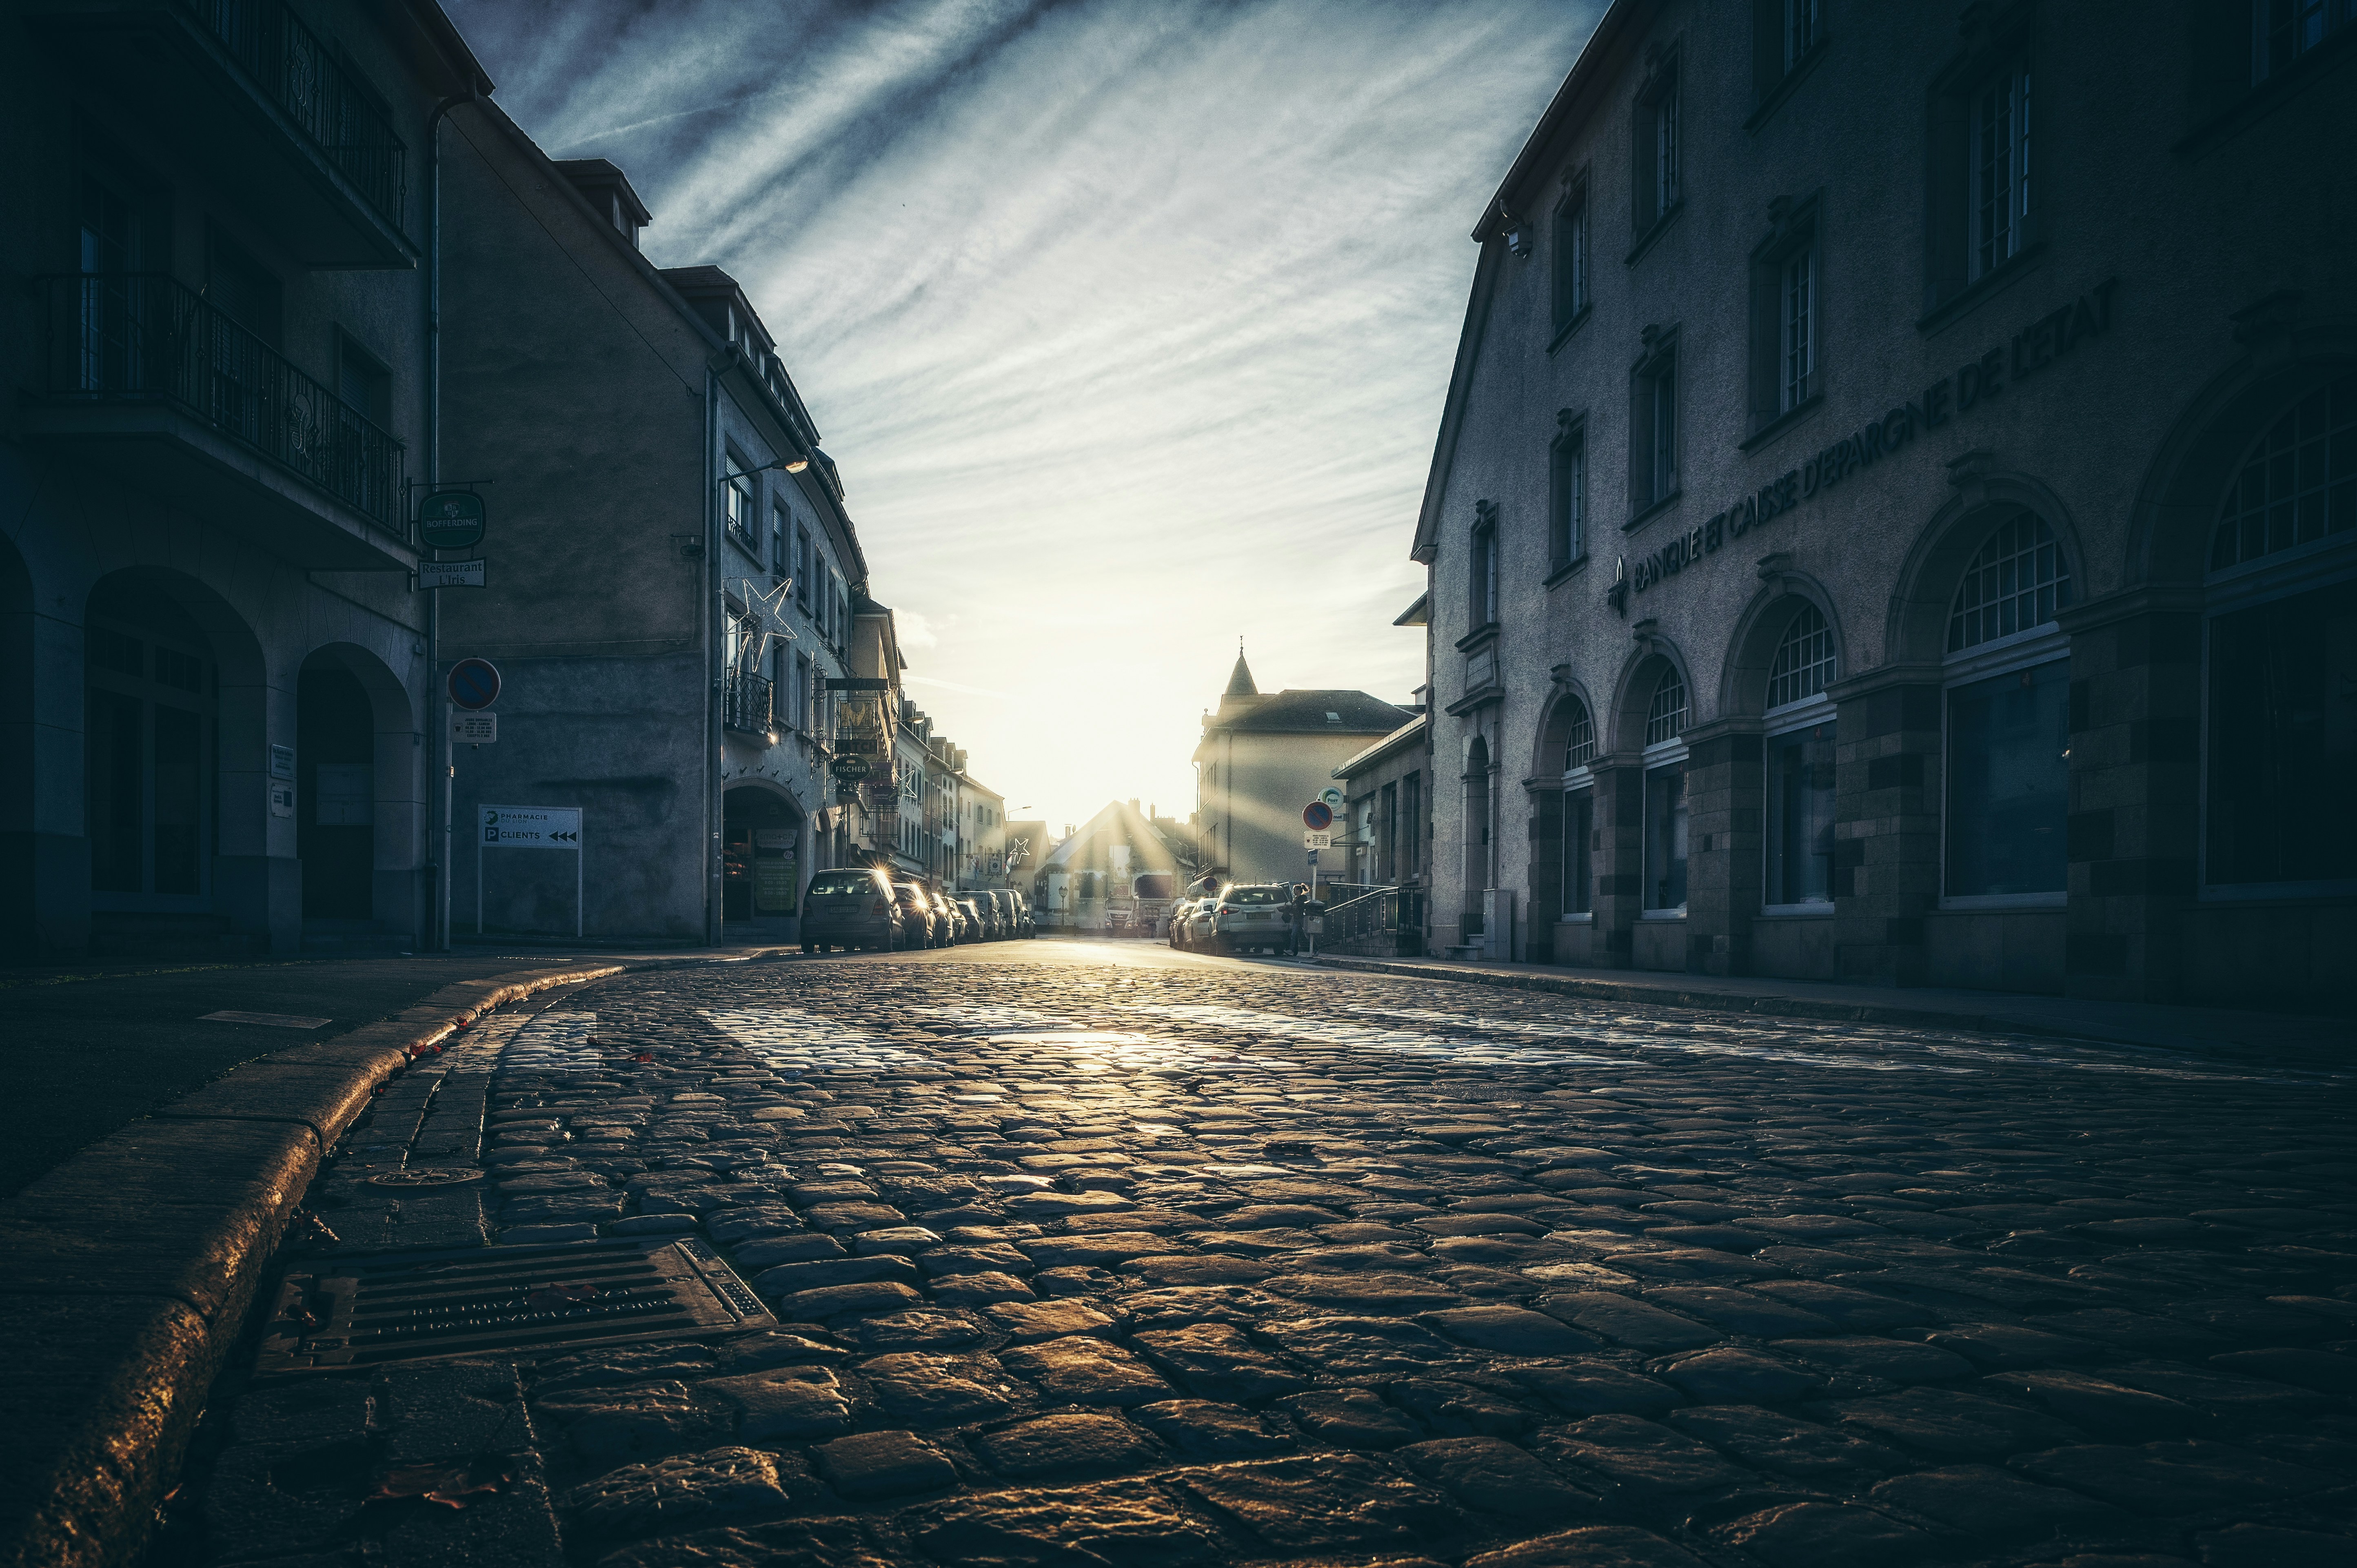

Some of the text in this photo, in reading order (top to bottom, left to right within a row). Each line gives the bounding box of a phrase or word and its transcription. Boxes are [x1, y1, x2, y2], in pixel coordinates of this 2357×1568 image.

[1633, 527, 1702, 592] BANQUE
[1704, 512, 1727, 553] ET
[1728, 469, 1798, 538] CAISSE
[1956, 347, 2000, 412] DE
[427, 519, 477, 527] BOFFERDING
[422, 562, 482, 573] Restaurant
[439, 574, 465, 585] L'Iris
